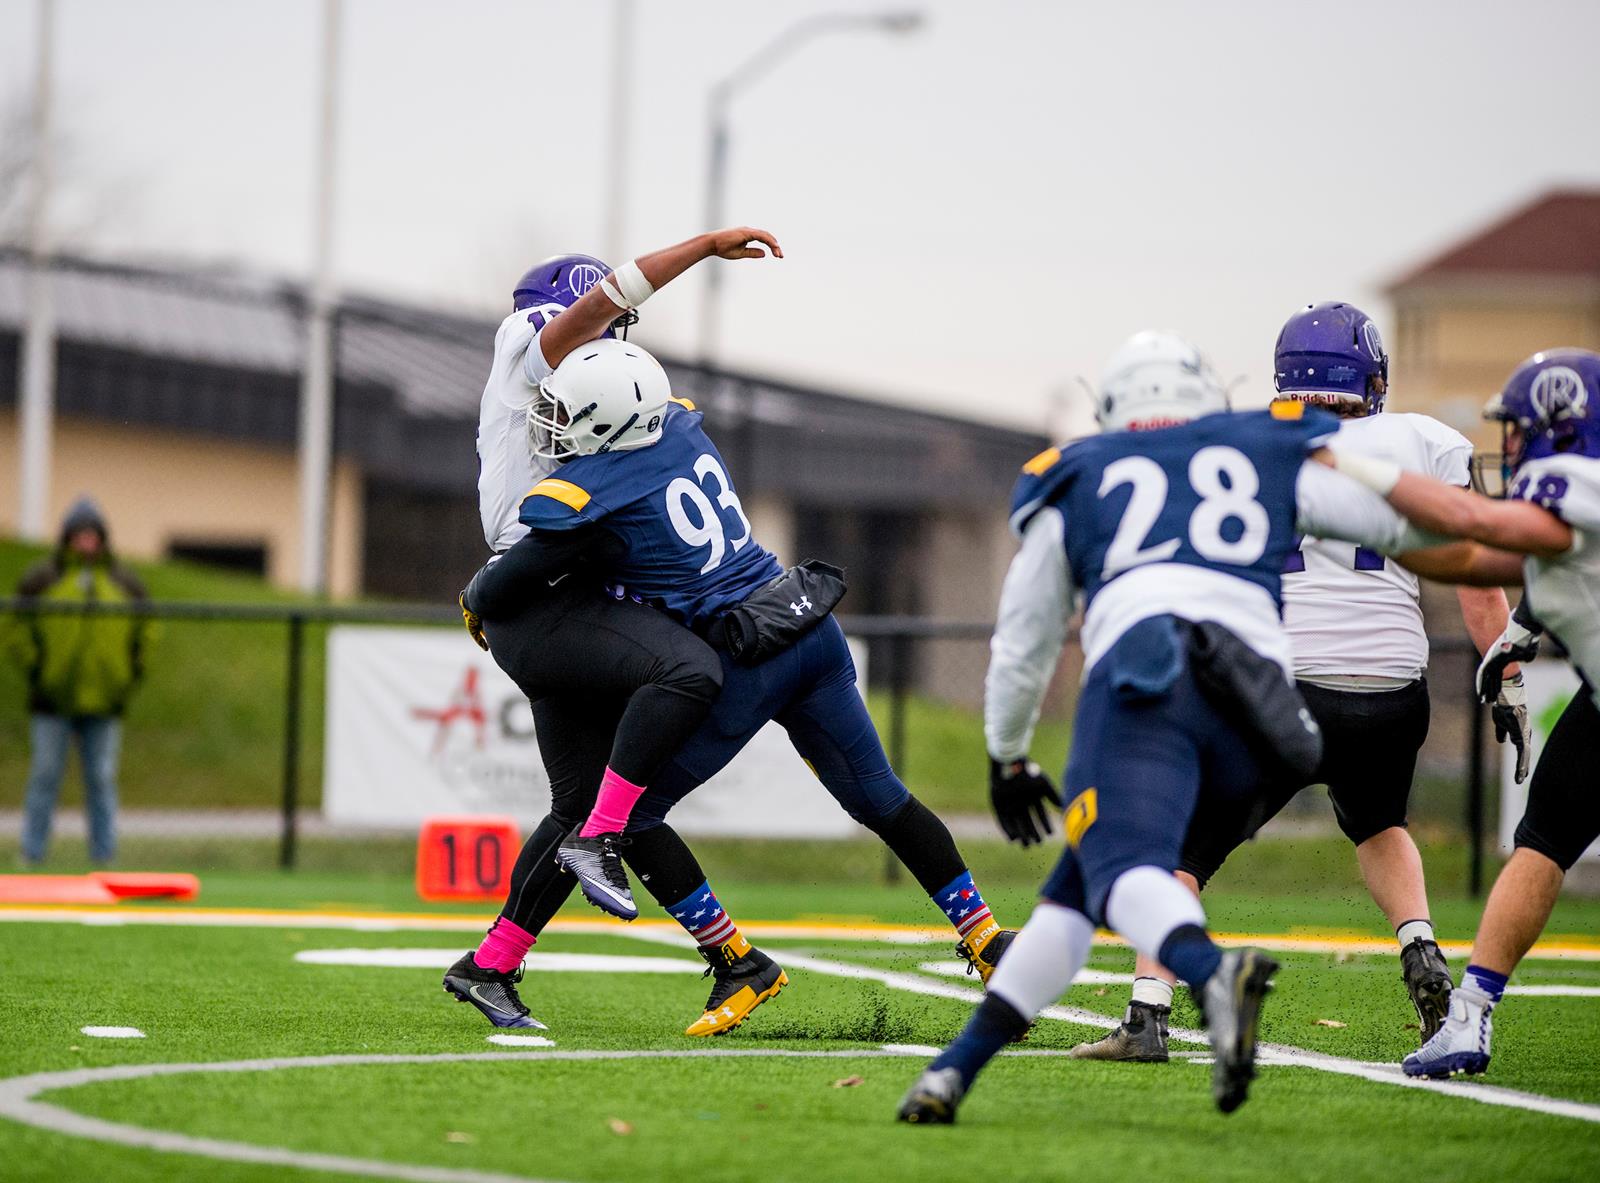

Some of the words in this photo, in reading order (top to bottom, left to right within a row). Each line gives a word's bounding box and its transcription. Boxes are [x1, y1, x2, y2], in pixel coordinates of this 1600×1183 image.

[665, 453, 752, 576] 93
[1097, 445, 1270, 581] 28
[443, 833, 501, 890] 10
